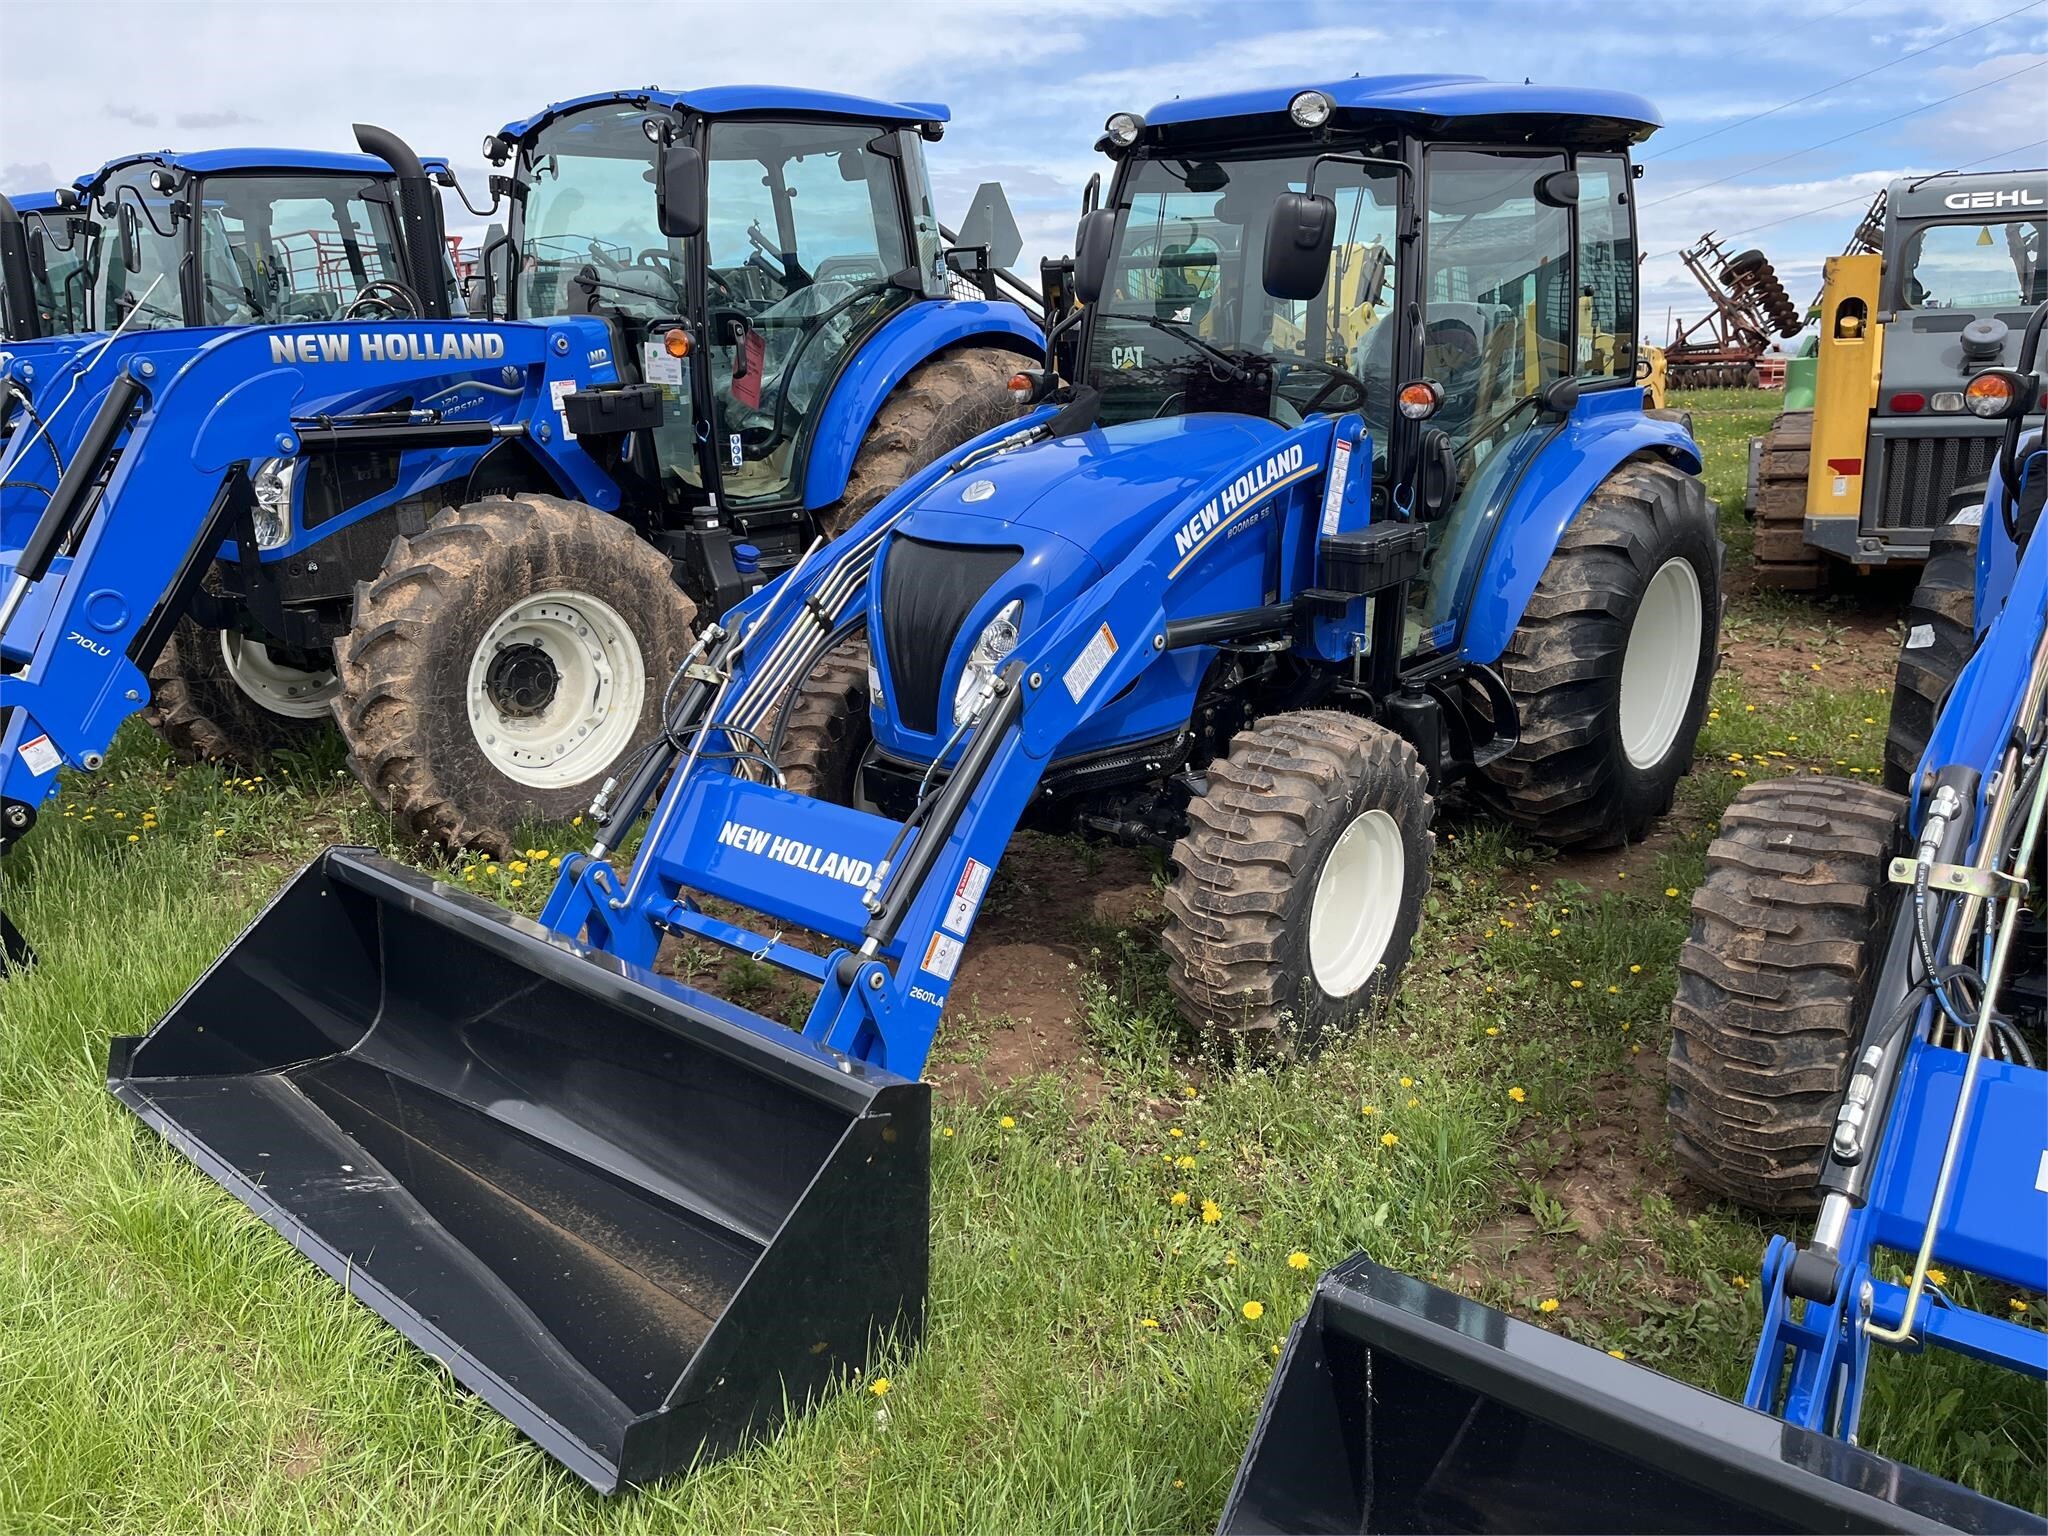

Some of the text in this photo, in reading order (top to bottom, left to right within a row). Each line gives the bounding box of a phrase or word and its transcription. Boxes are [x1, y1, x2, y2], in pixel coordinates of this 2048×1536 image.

[1944, 189, 2044, 210] GEHL
[269, 333, 504, 364] NEW HOLLAND
[1111, 346, 1145, 370] CAT
[1174, 498, 1220, 557] NEW
[1221, 444, 1303, 515] HOLLAND
[1227, 513, 1259, 539] BOOMER
[66, 631, 111, 657] 710LU
[717, 820, 873, 888] NEW HOLLAND
[909, 986, 945, 1010] 260TLA
